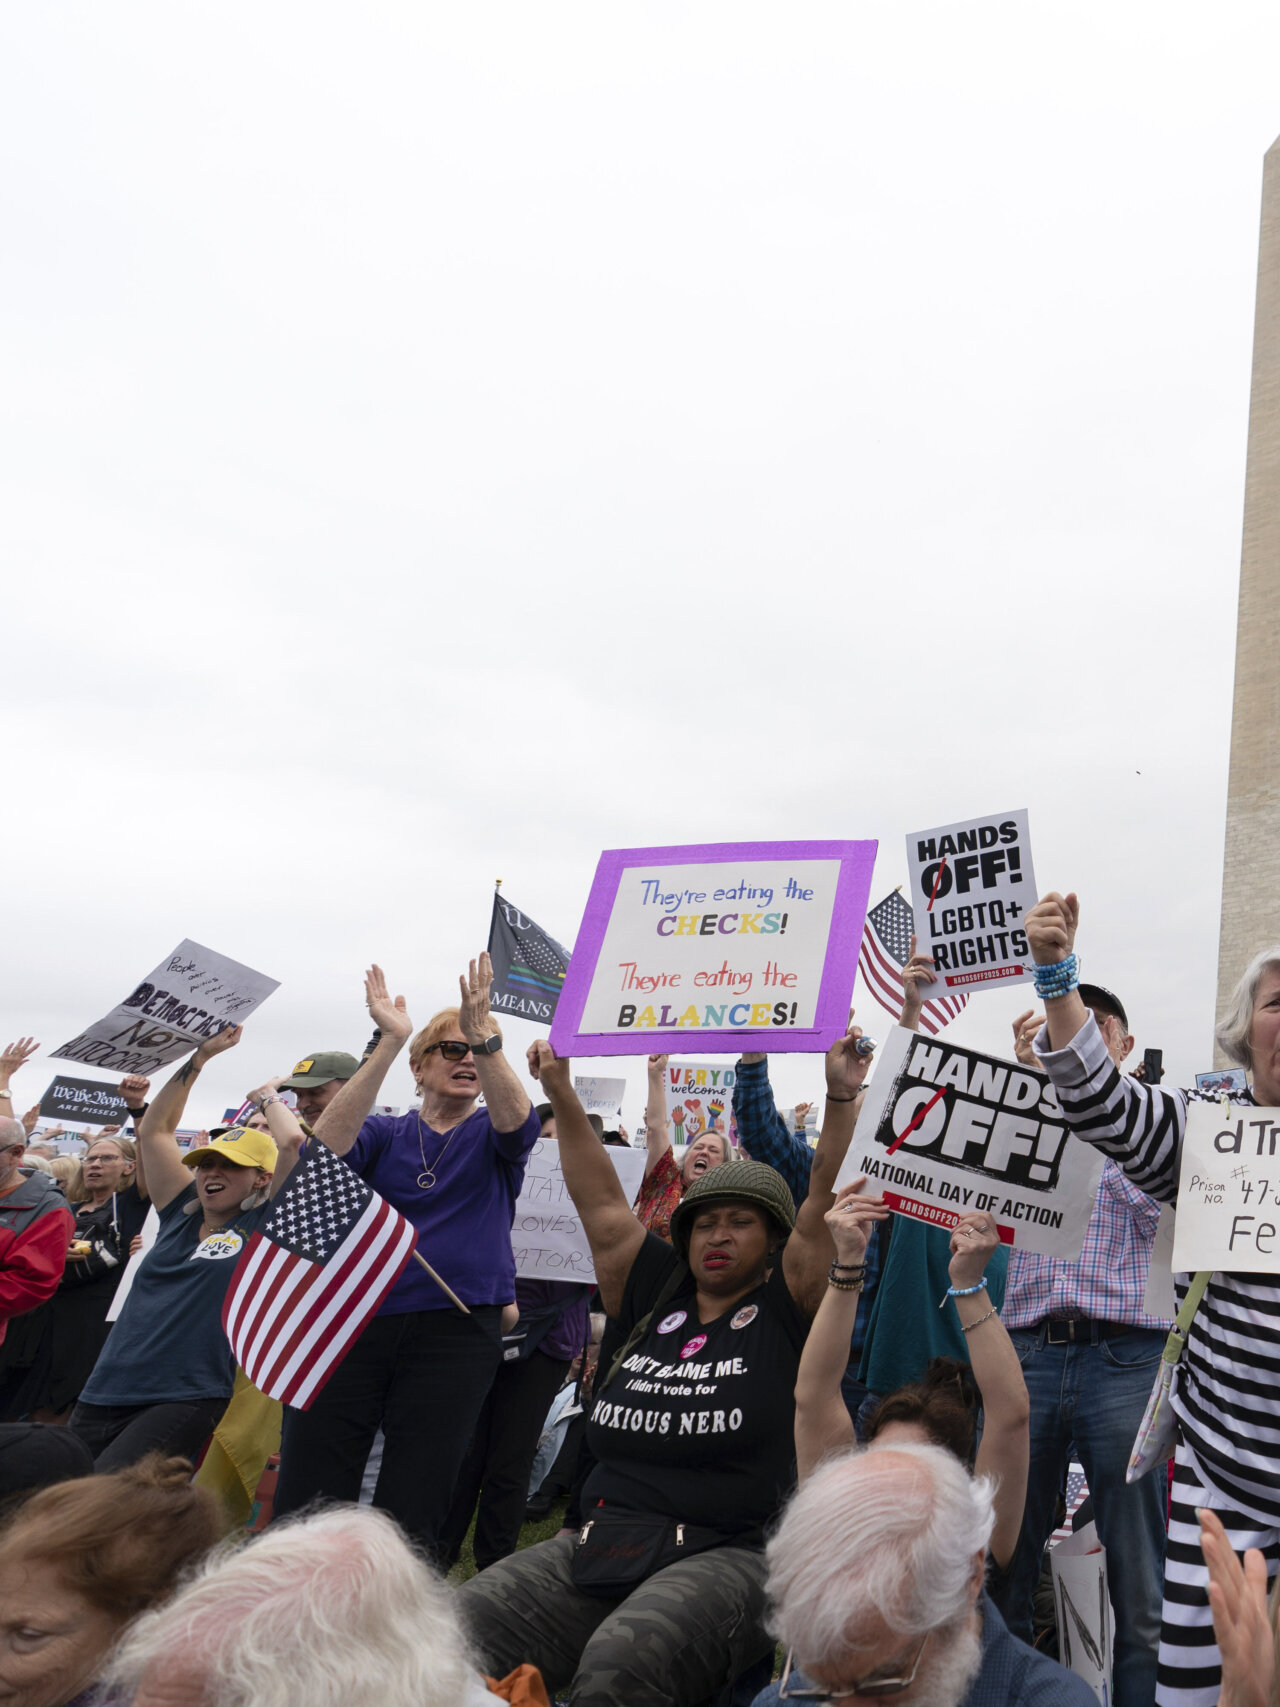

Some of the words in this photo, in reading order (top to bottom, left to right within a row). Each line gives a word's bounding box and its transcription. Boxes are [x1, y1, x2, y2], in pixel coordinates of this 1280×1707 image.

[917, 820, 1019, 862] HANDS
[920, 846, 1023, 900] OFF!
[640, 879, 707, 914] They're
[712, 879, 774, 909] eating
[782, 877, 814, 902] the
[656, 912, 789, 937] CHECKS!
[929, 900, 1023, 938] LGBTQ+
[166, 956, 197, 974] People
[931, 929, 1029, 972] RIGHTS
[693, 960, 753, 996] eating
[762, 960, 799, 988] the
[953, 967, 1016, 985] HANDSOFF2025.COM
[490, 991, 553, 1018] MEANS
[617, 1002, 798, 1028] BALANCES!
[110, 1019, 193, 1053] NOT
[57, 1034, 174, 1076] AUTOCRACY
[662, 1067, 735, 1087] VERYO
[671, 1079, 727, 1096] welcome
[907, 1042, 1065, 1120] HANDS
[57, 1103, 79, 1112] ARE
[82, 1107, 118, 1118] PISSED
[892, 1085, 1065, 1183] OFF!
[860, 1155, 934, 1195] NATIONAL
[938, 1180, 974, 1207] DAY
[975, 1191, 999, 1213] OF
[1000, 1199, 1064, 1229] ACTION
[1189, 1175, 1226, 1193] Prison
[899, 1199, 962, 1228] HANDSOFF20
[201, 1241, 233, 1255] LOVE
[714, 1357, 748, 1378] ME.
[662, 1384, 692, 1396] vote
[695, 1383, 718, 1395] for
[590, 1399, 672, 1435] NOXIOUS
[678, 1407, 743, 1436] NERO
